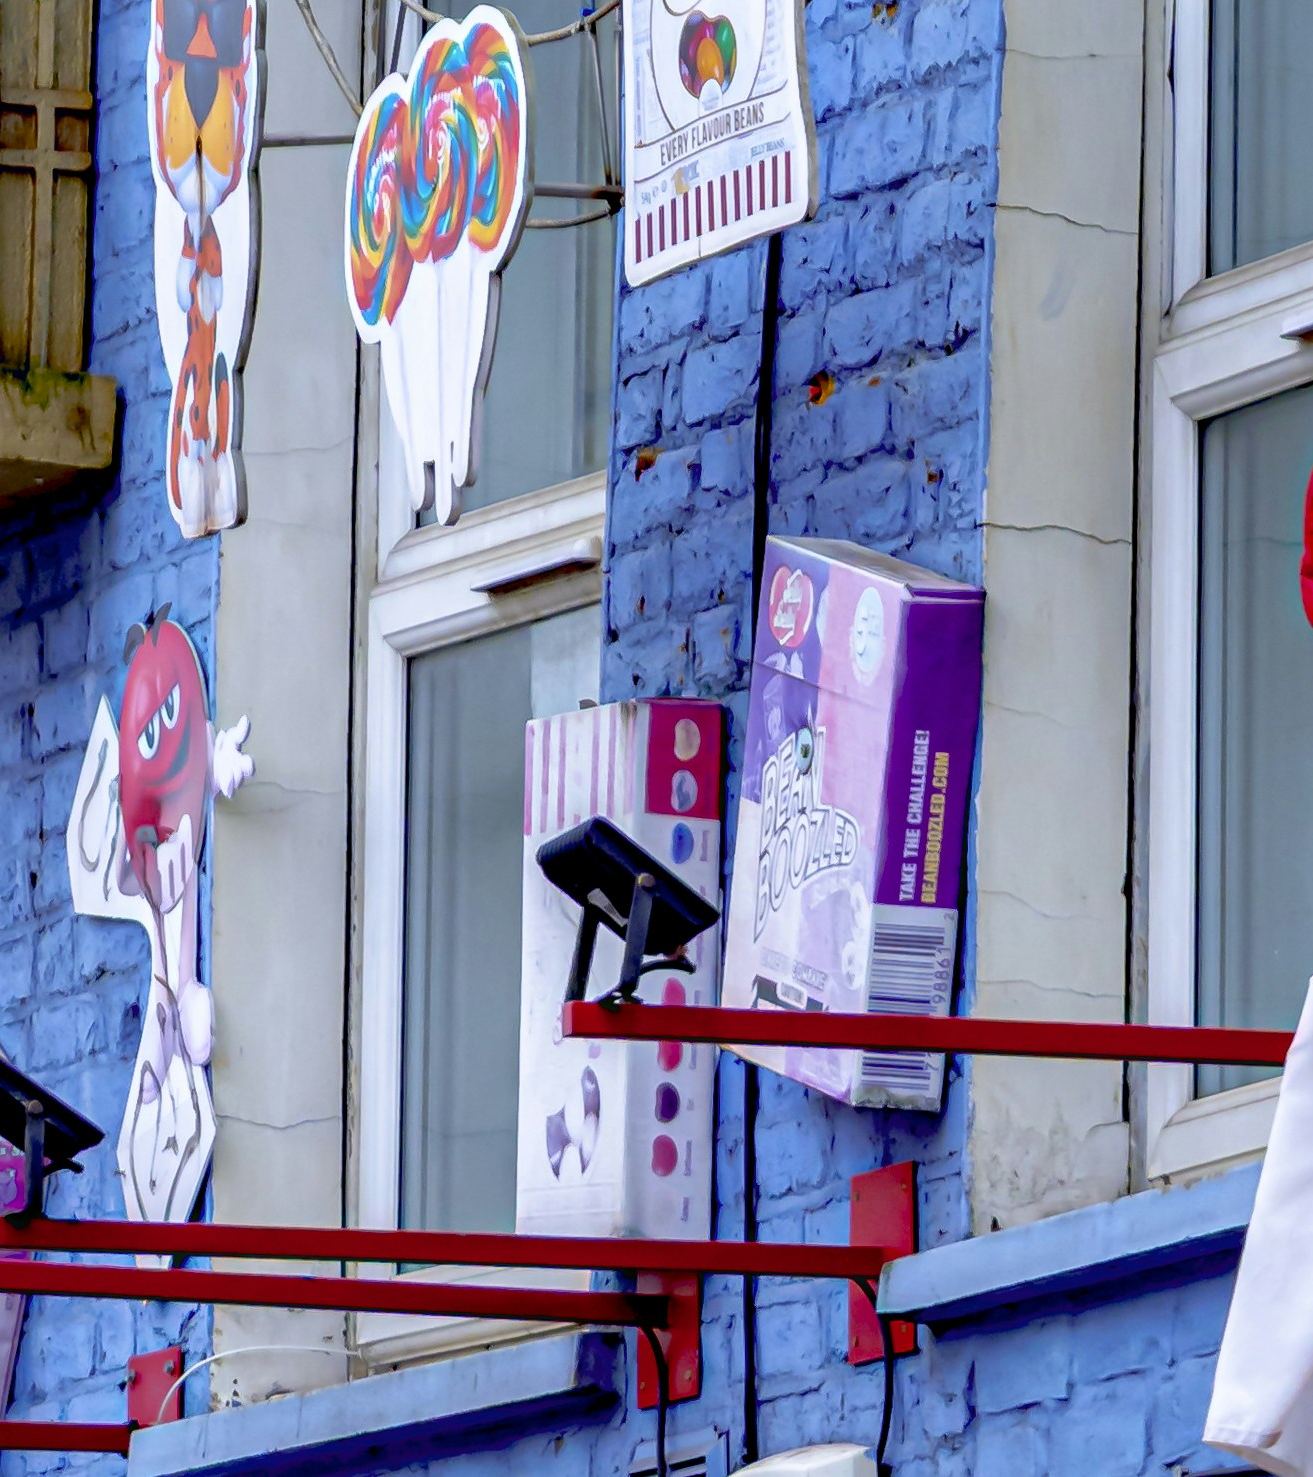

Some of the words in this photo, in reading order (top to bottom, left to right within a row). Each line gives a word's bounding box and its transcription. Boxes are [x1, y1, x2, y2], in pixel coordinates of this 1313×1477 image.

[660, 130, 689, 166] EVERY
[691, 115, 731, 149] FLAVOUR
[734, 101, 765, 132] BEANS
[906, 729, 930, 824] CHALLENGE!
[903, 829, 920, 858] THE
[921, 752, 949, 903] BEANBOOZLED.COM
[753, 805, 861, 943] BOOZLED
[899, 863, 917, 902] TAKE
